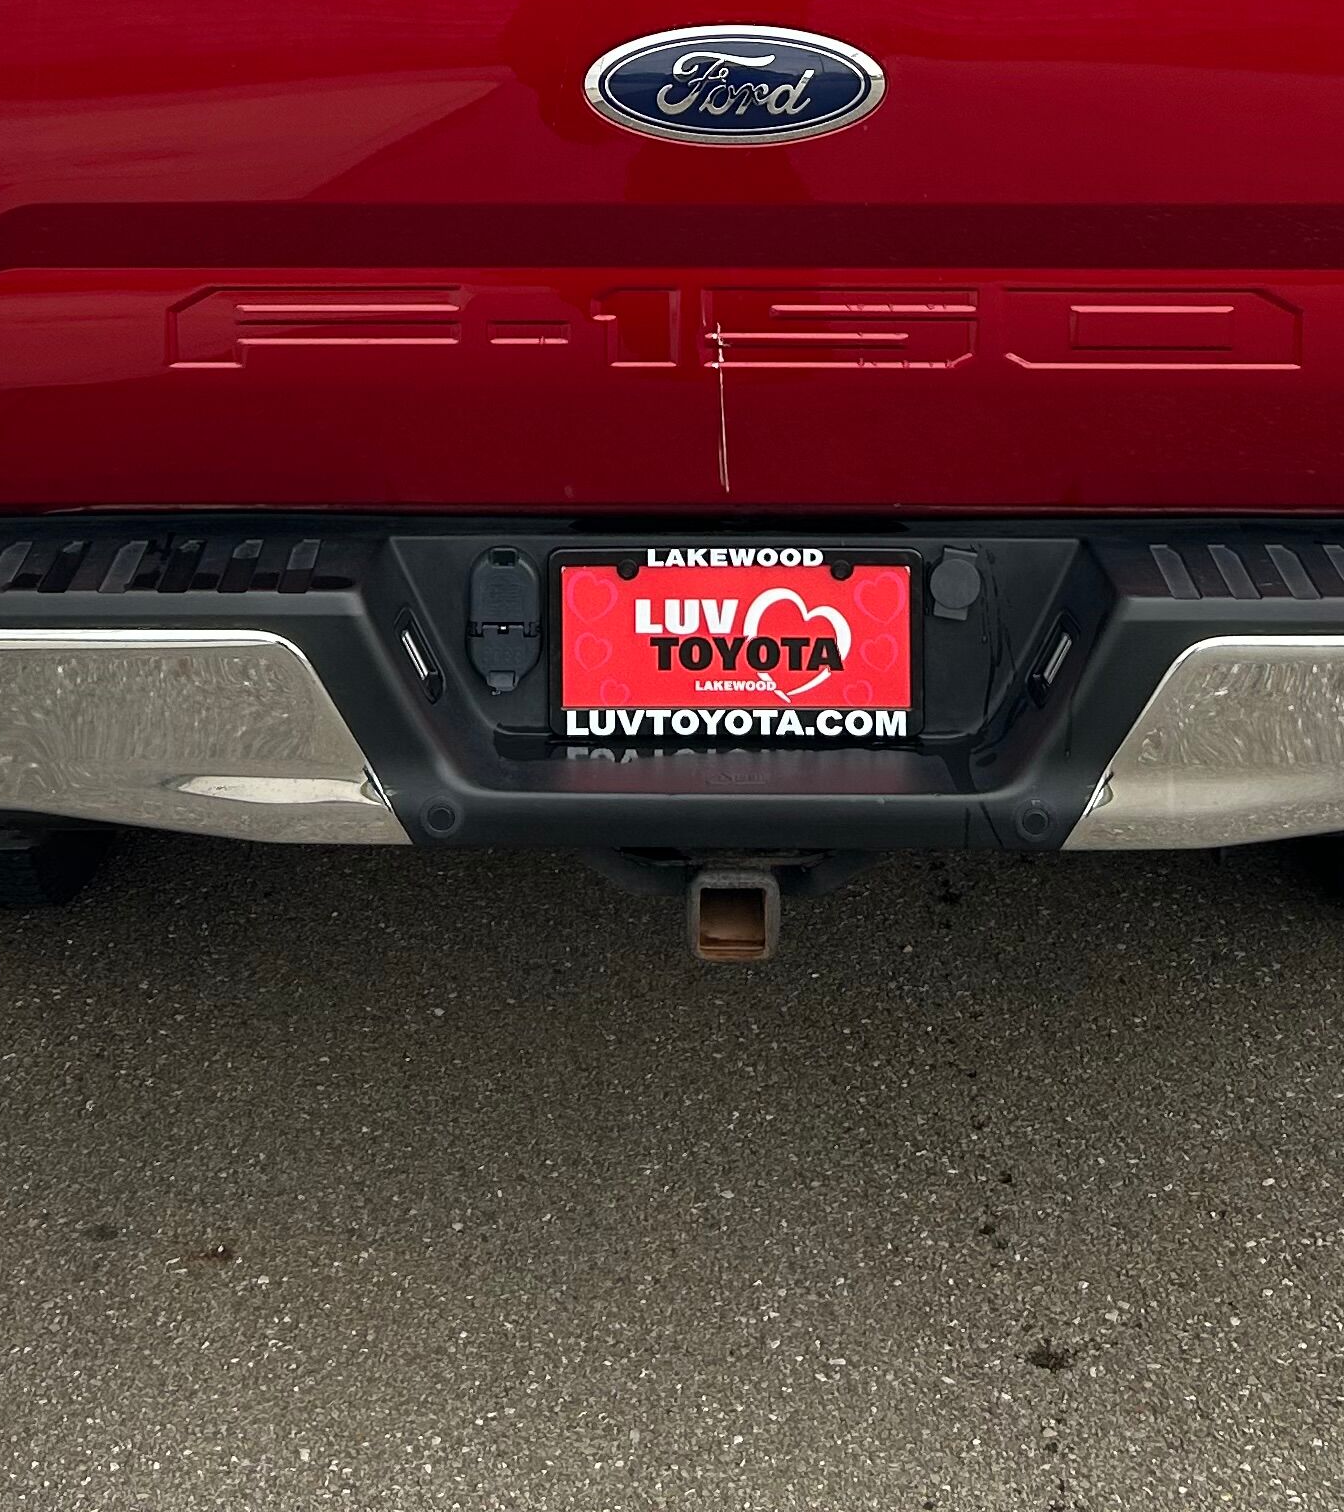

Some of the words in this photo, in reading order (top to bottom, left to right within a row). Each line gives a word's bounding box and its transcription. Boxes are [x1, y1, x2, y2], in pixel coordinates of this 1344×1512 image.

[656, 50, 814, 116] Ford
[166, 285, 1302, 370] F-150
[647, 548, 824, 567] LAKEWOOD
[634, 599, 739, 635] LUV
[650, 637, 844, 671] TOYOTA
[695, 680, 777, 692] LAKEWOOD
[566, 709, 907, 736] LUVTOYOTA.COM
